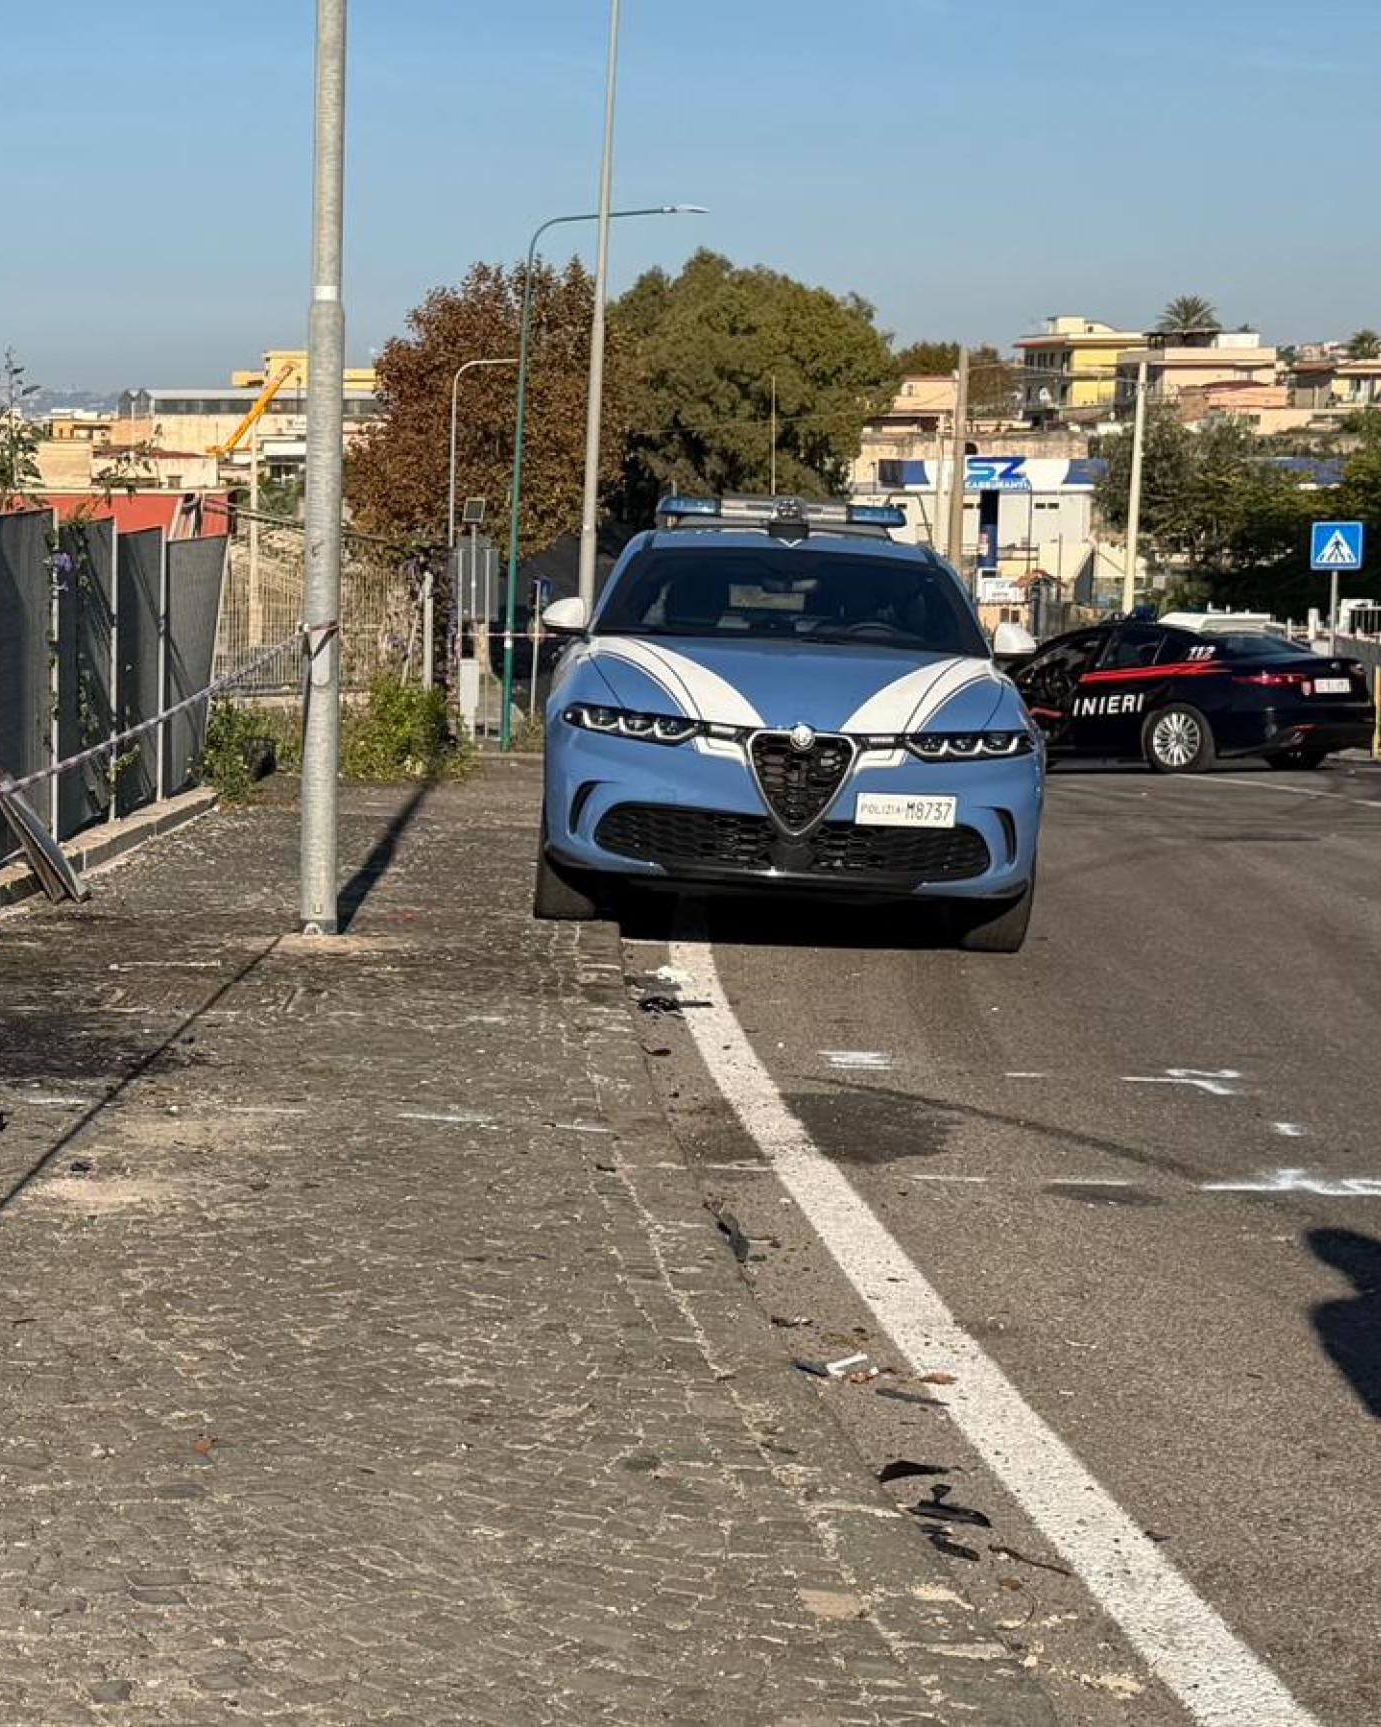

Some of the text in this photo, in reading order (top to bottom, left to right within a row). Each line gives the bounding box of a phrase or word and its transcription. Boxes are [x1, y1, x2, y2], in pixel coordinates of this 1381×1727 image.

[966, 456, 1026, 481] SZ
[1186, 646, 1217, 661] 112
[1073, 693, 1144, 718] INIERI
[905, 801, 953, 822] M8737
